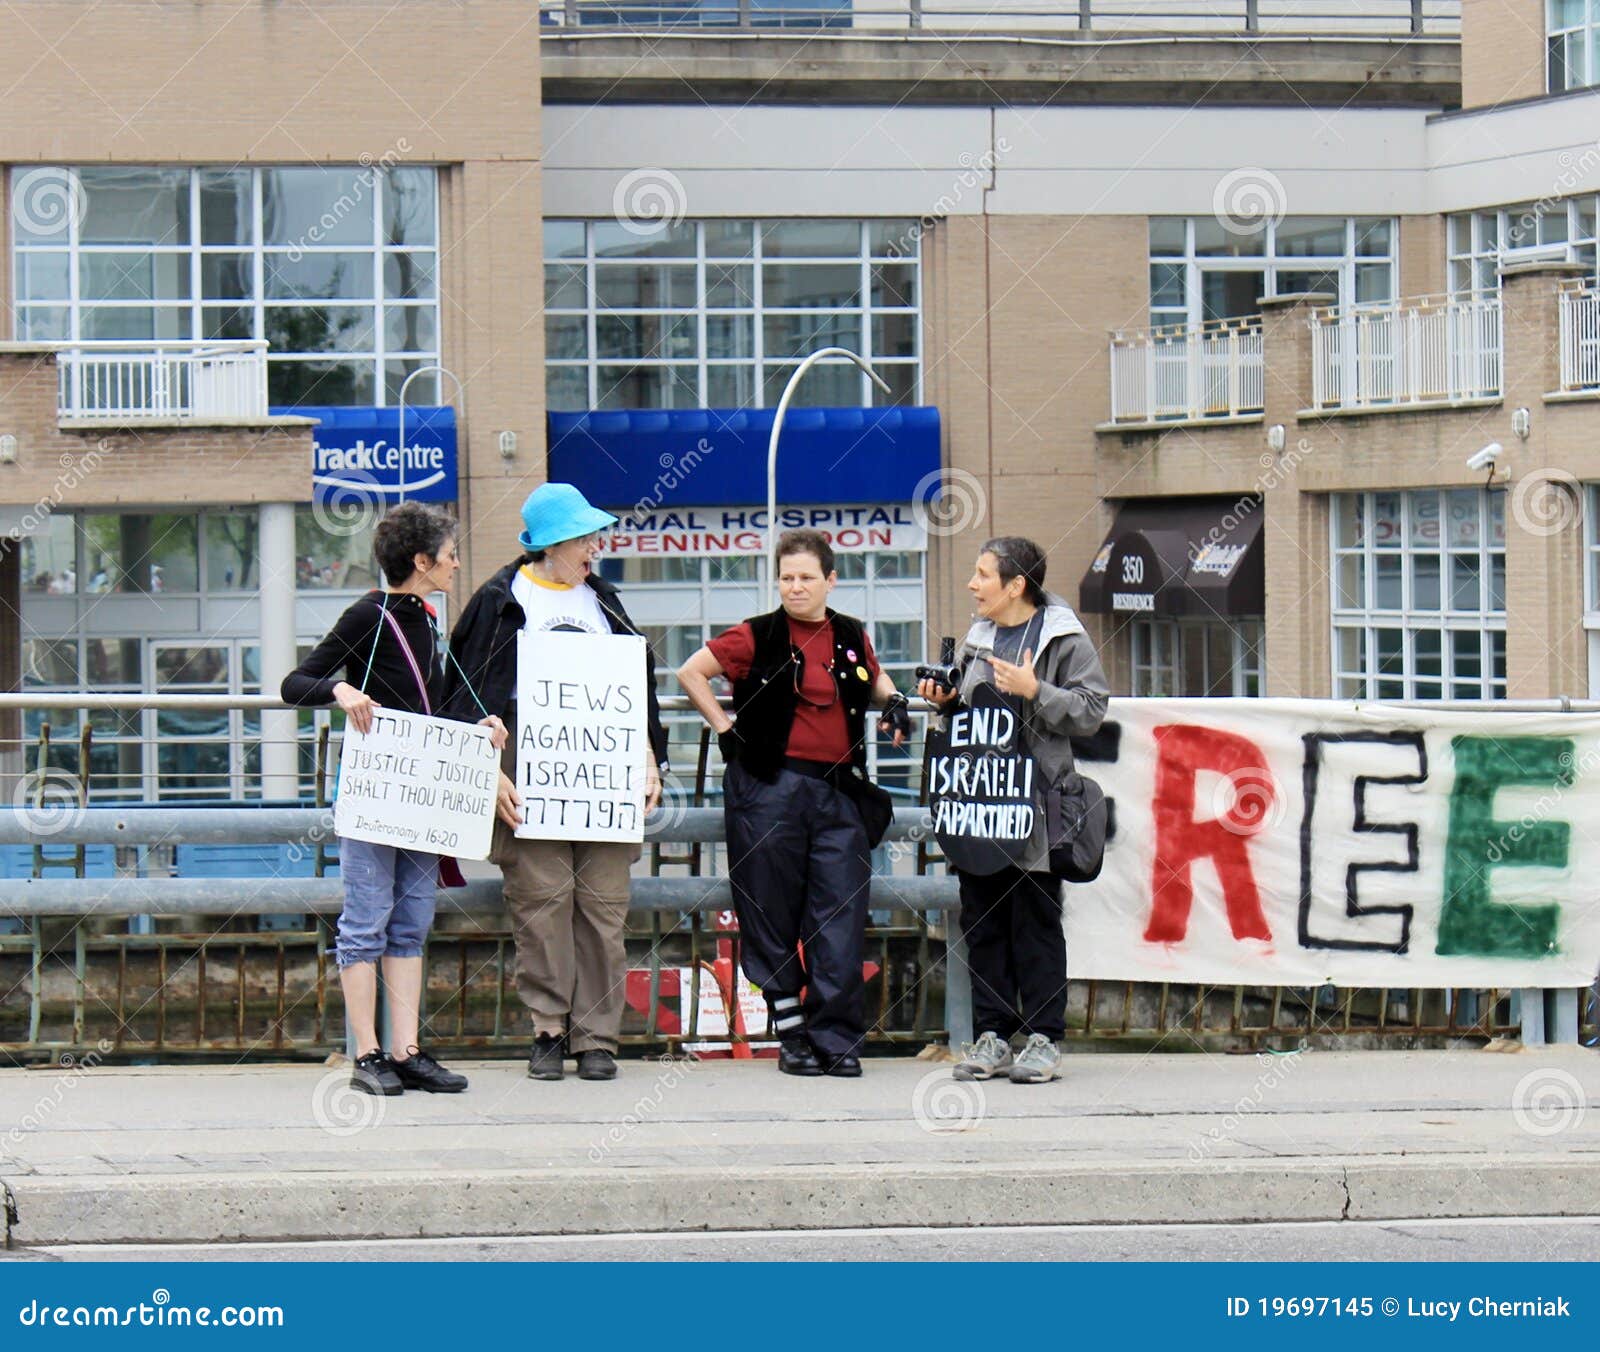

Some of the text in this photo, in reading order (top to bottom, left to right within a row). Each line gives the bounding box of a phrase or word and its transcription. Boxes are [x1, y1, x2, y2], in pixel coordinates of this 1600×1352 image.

[722, 507, 912, 529] HOSPITAL
[1122, 555, 1144, 584] 350
[532, 679, 632, 714] JEWS
[520, 724, 637, 752] AGAINST
[951, 707, 1014, 748] END
[349, 748, 495, 791] JUSTICE JUSTICE
[525, 760, 632, 791] ISRAELI
[343, 775, 490, 817] SHALT THOU PURSUE
[523, 797, 637, 830] הפרדה
[934, 800, 1034, 840] APARTHEID
[355, 815, 420, 844] Deuteronomy
[425, 827, 459, 848] 16:20
